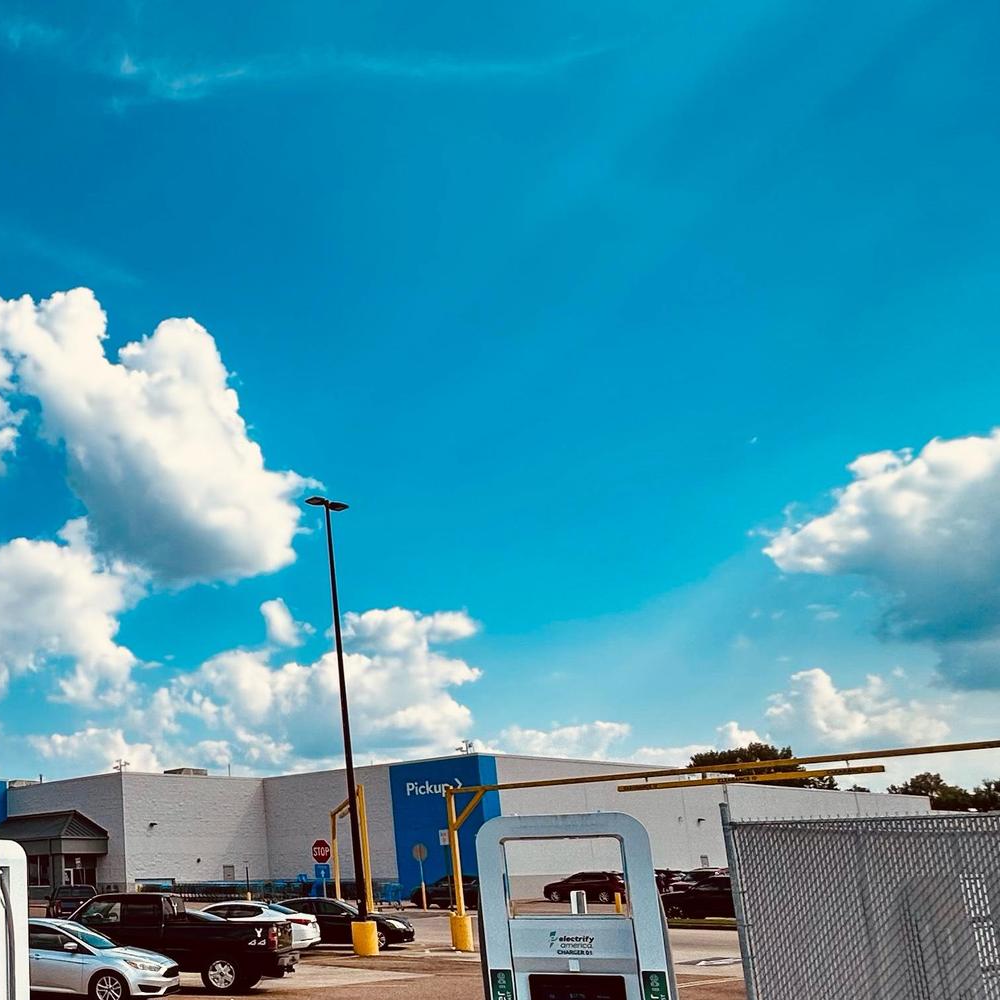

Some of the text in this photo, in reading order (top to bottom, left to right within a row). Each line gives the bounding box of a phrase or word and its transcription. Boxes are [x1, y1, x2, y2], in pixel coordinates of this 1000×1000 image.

[406, 780, 450, 797] Pickup
[313, 846, 330, 856] STOP
[558, 935, 594, 943] electrify
